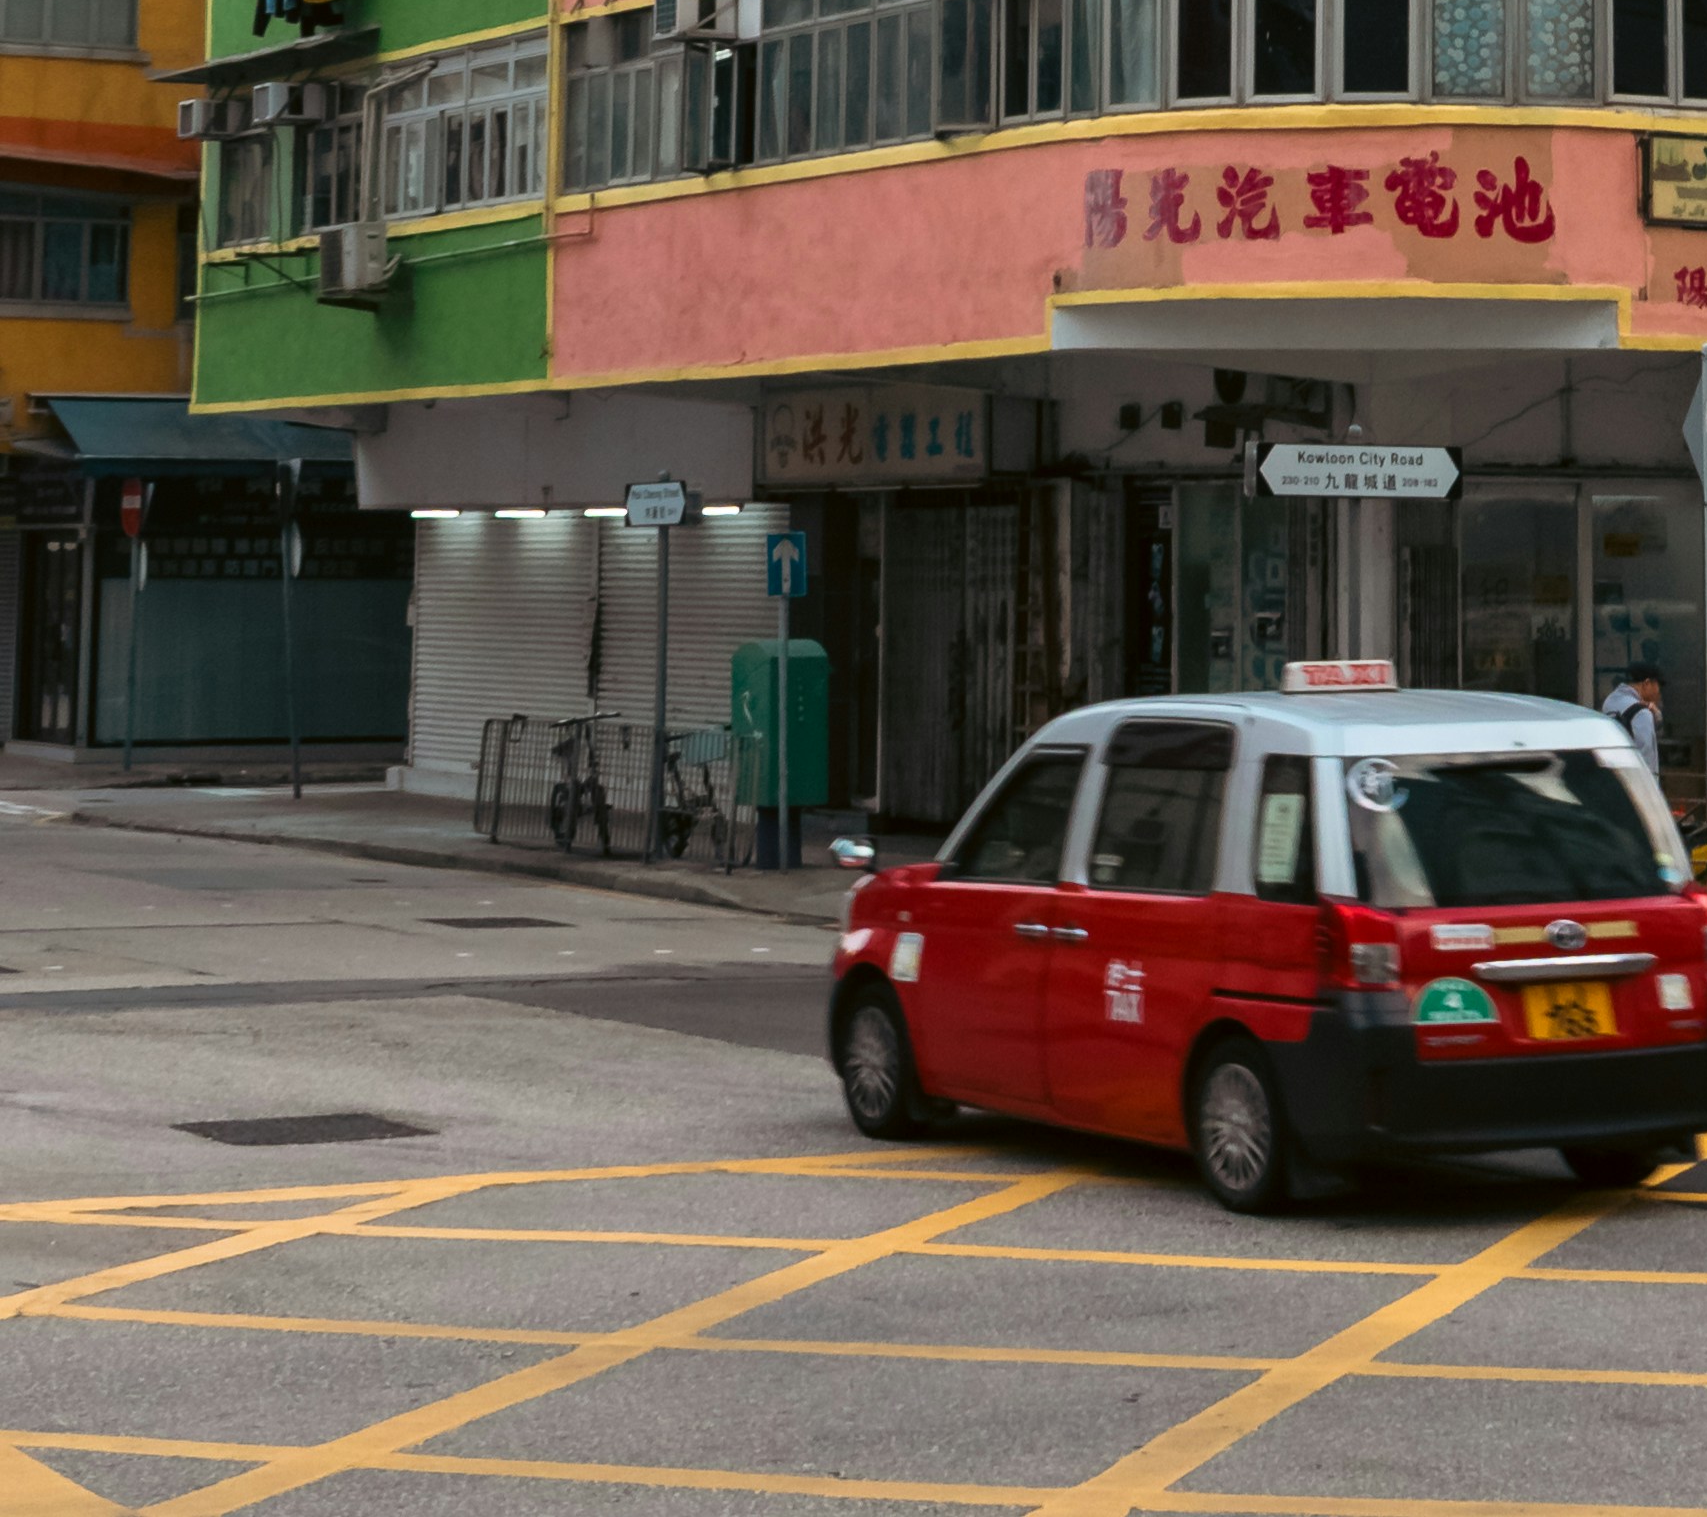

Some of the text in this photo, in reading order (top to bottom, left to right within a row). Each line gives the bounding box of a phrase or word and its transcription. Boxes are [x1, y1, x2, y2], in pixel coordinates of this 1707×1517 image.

[1084, 151, 1556, 249] 陽光汽車電池
[1297, 450, 1423, 468] Kowloon City Road
[1325, 472, 1397, 491] 九龍城道
[1303, 664, 1387, 685] TAXI
